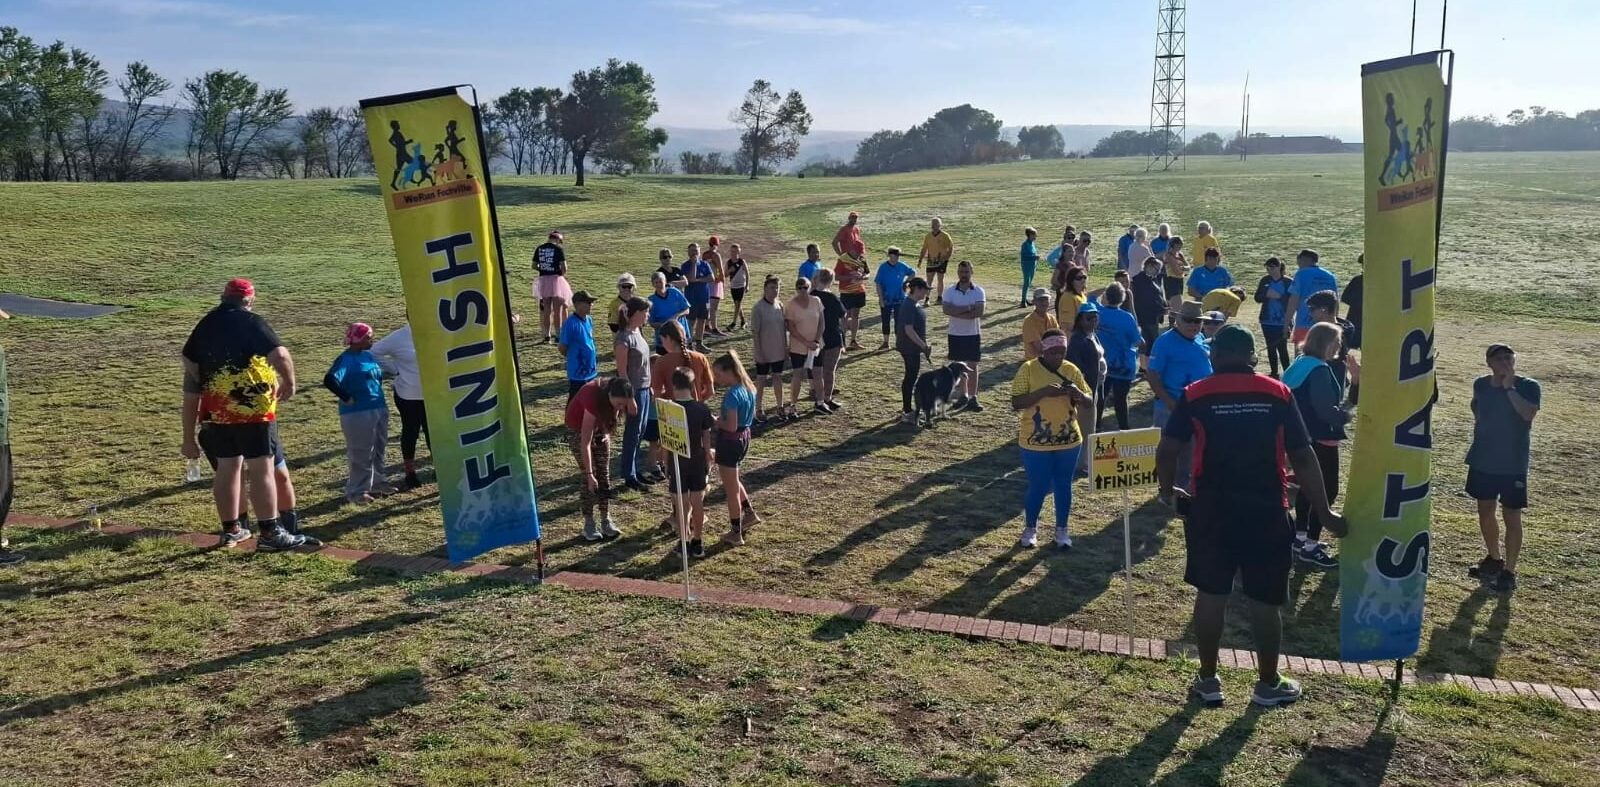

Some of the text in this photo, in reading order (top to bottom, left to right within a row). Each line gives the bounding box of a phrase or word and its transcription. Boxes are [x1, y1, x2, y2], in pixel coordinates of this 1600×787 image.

[403, 190, 435, 203] WeRun
[425, 231, 512, 492] FINISH
[1376, 258, 1434, 579] START
[1103, 471, 1150, 489] FINISH
